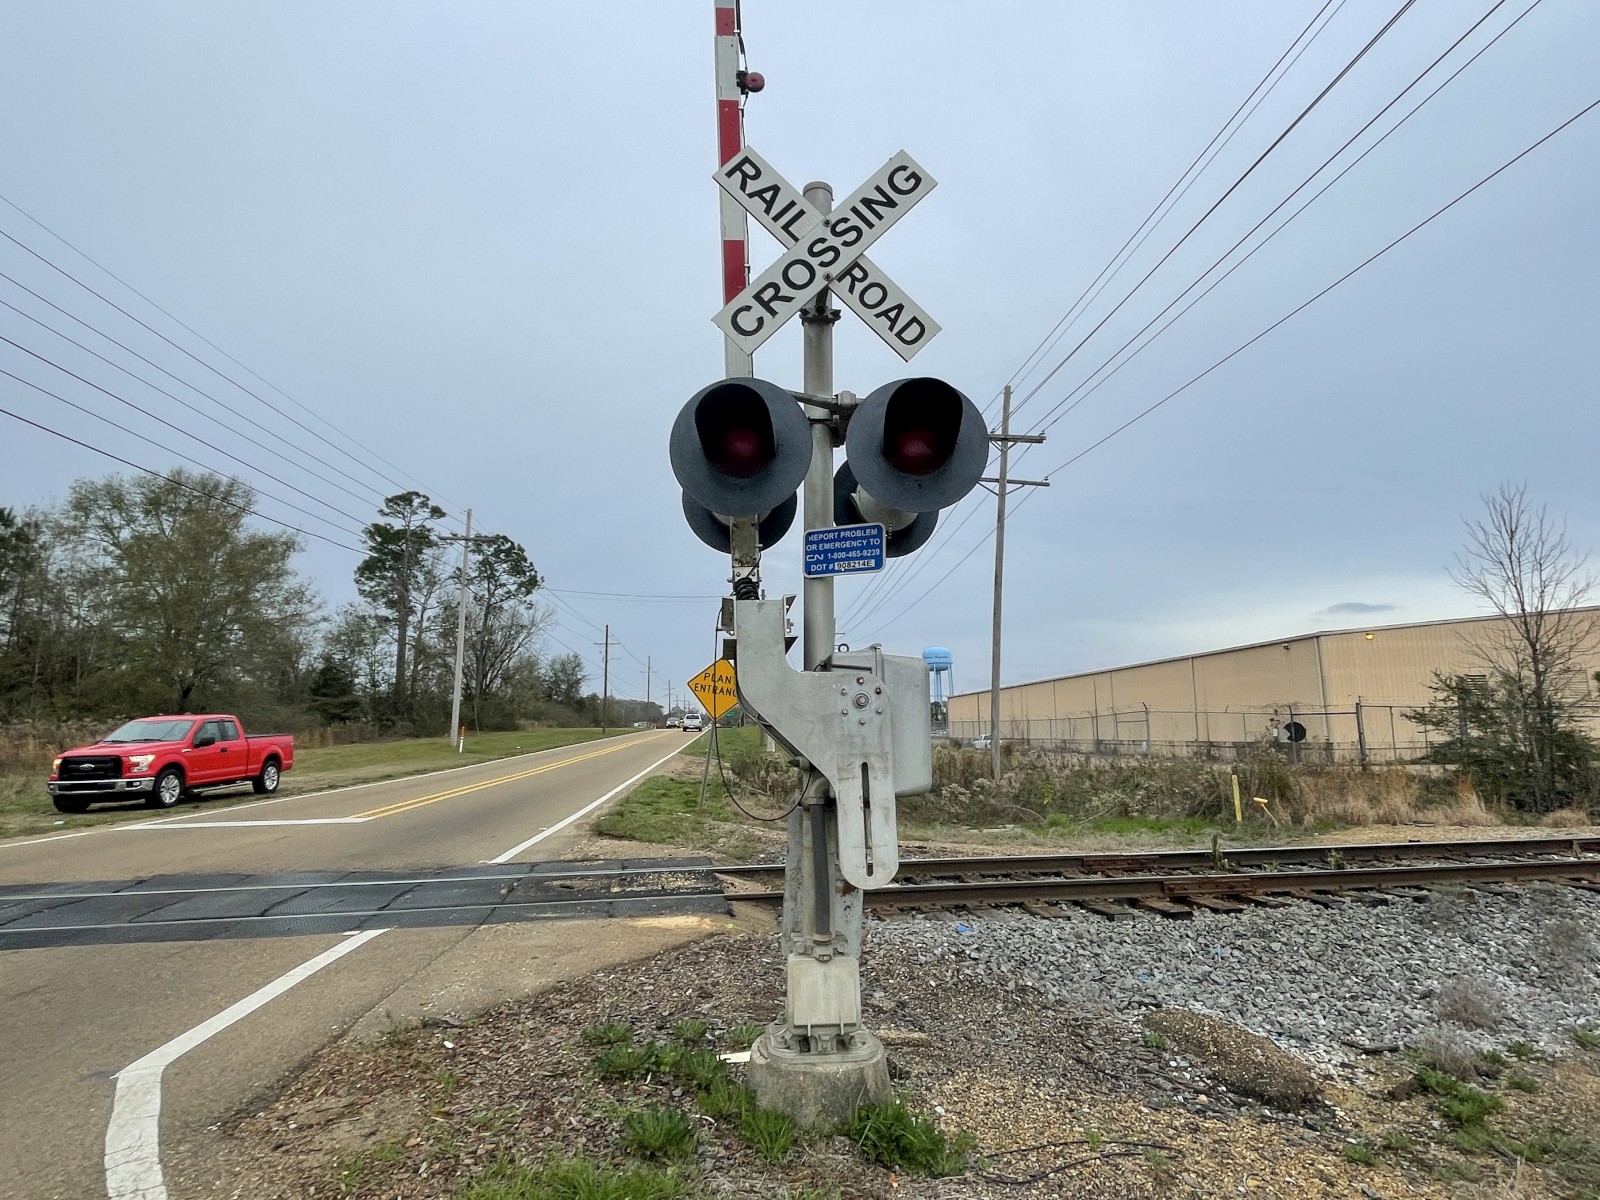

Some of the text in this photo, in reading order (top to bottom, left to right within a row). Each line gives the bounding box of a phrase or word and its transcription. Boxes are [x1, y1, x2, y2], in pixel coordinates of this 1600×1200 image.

[724, 155, 926, 346] RAIL ROAD
[730, 164, 923, 337] CROSSING
[808, 528, 878, 542] REPORT PROBLEM
[805, 538, 881, 552] OR EMERGENCY TO
[806, 549, 880, 562] CN 1-800-465-9239
[810, 563, 828, 572] DOT
[836, 560, 873, 570] 908214E
[703, 672, 735, 685] PLAN
[694, 682, 737, 698] ENTRANC
